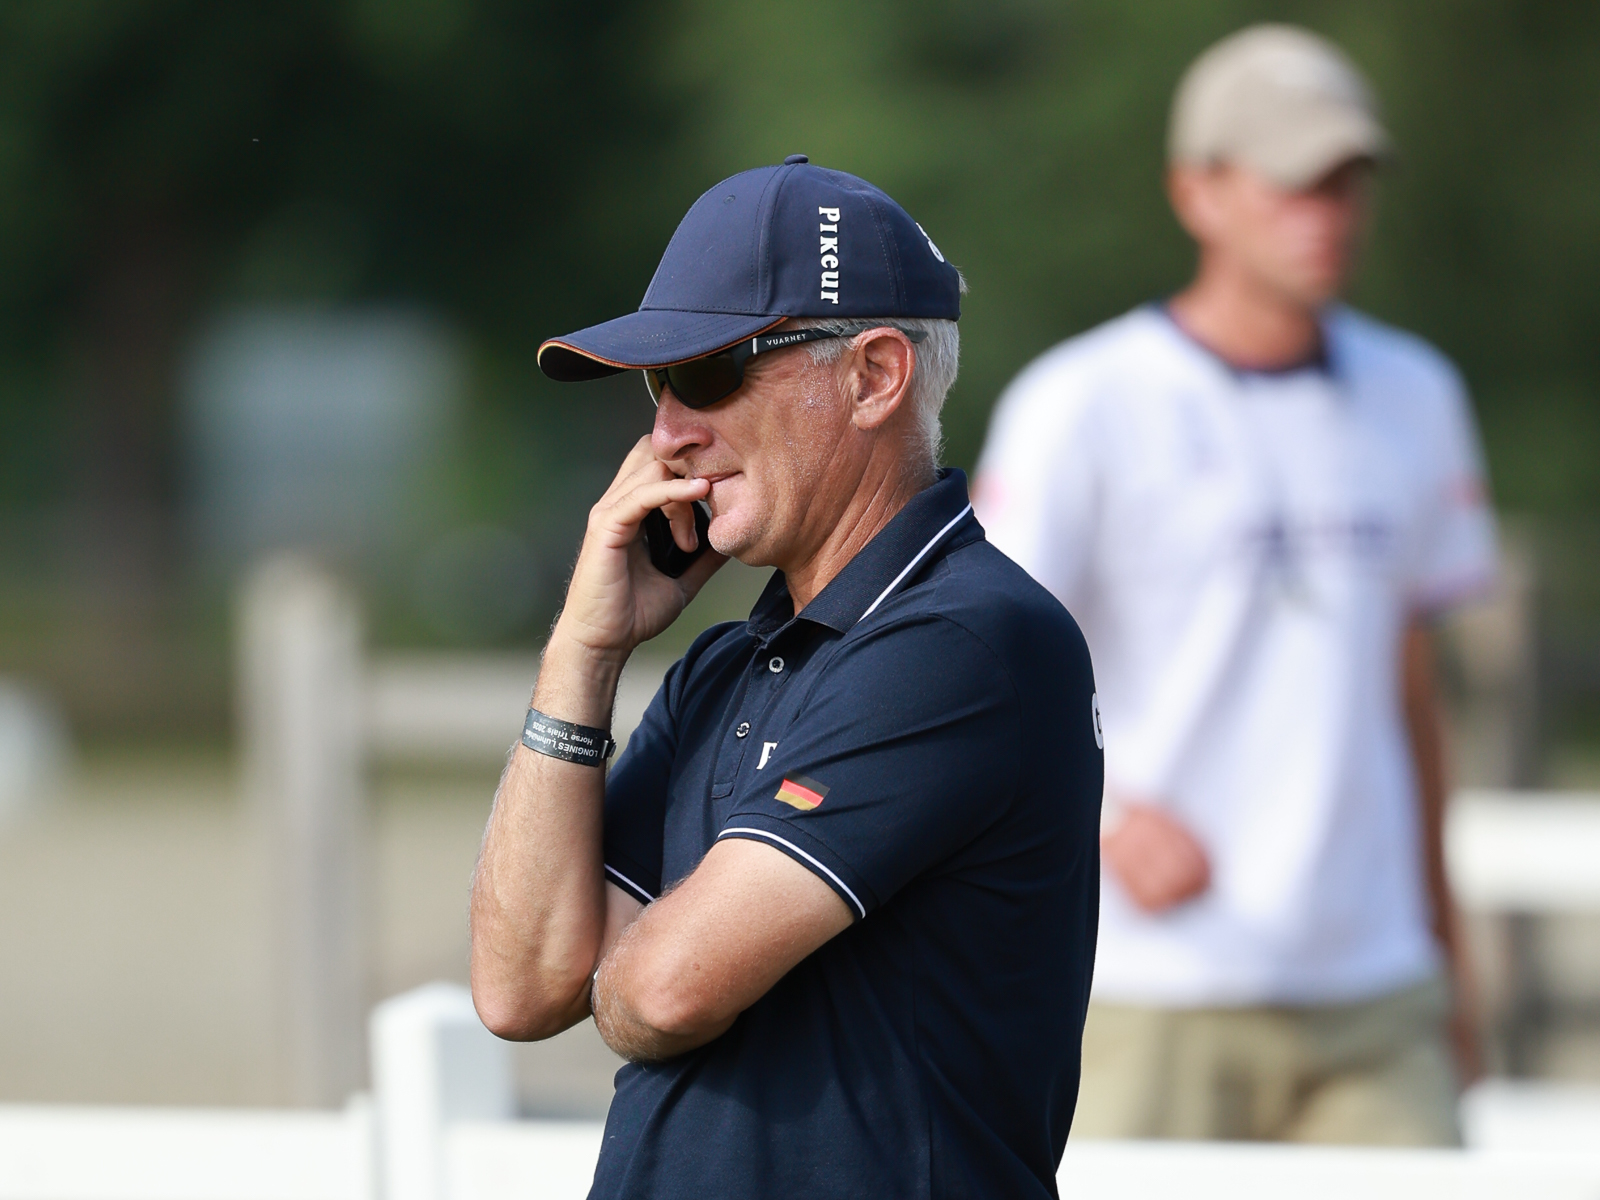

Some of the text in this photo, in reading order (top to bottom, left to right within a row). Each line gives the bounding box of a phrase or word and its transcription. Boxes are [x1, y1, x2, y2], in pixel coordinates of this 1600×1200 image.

[766, 333, 807, 346] VUARNET
[547, 727, 569, 740] Trials
[570, 735, 594, 746] Horse
[557, 742, 599, 758] LONGINES
